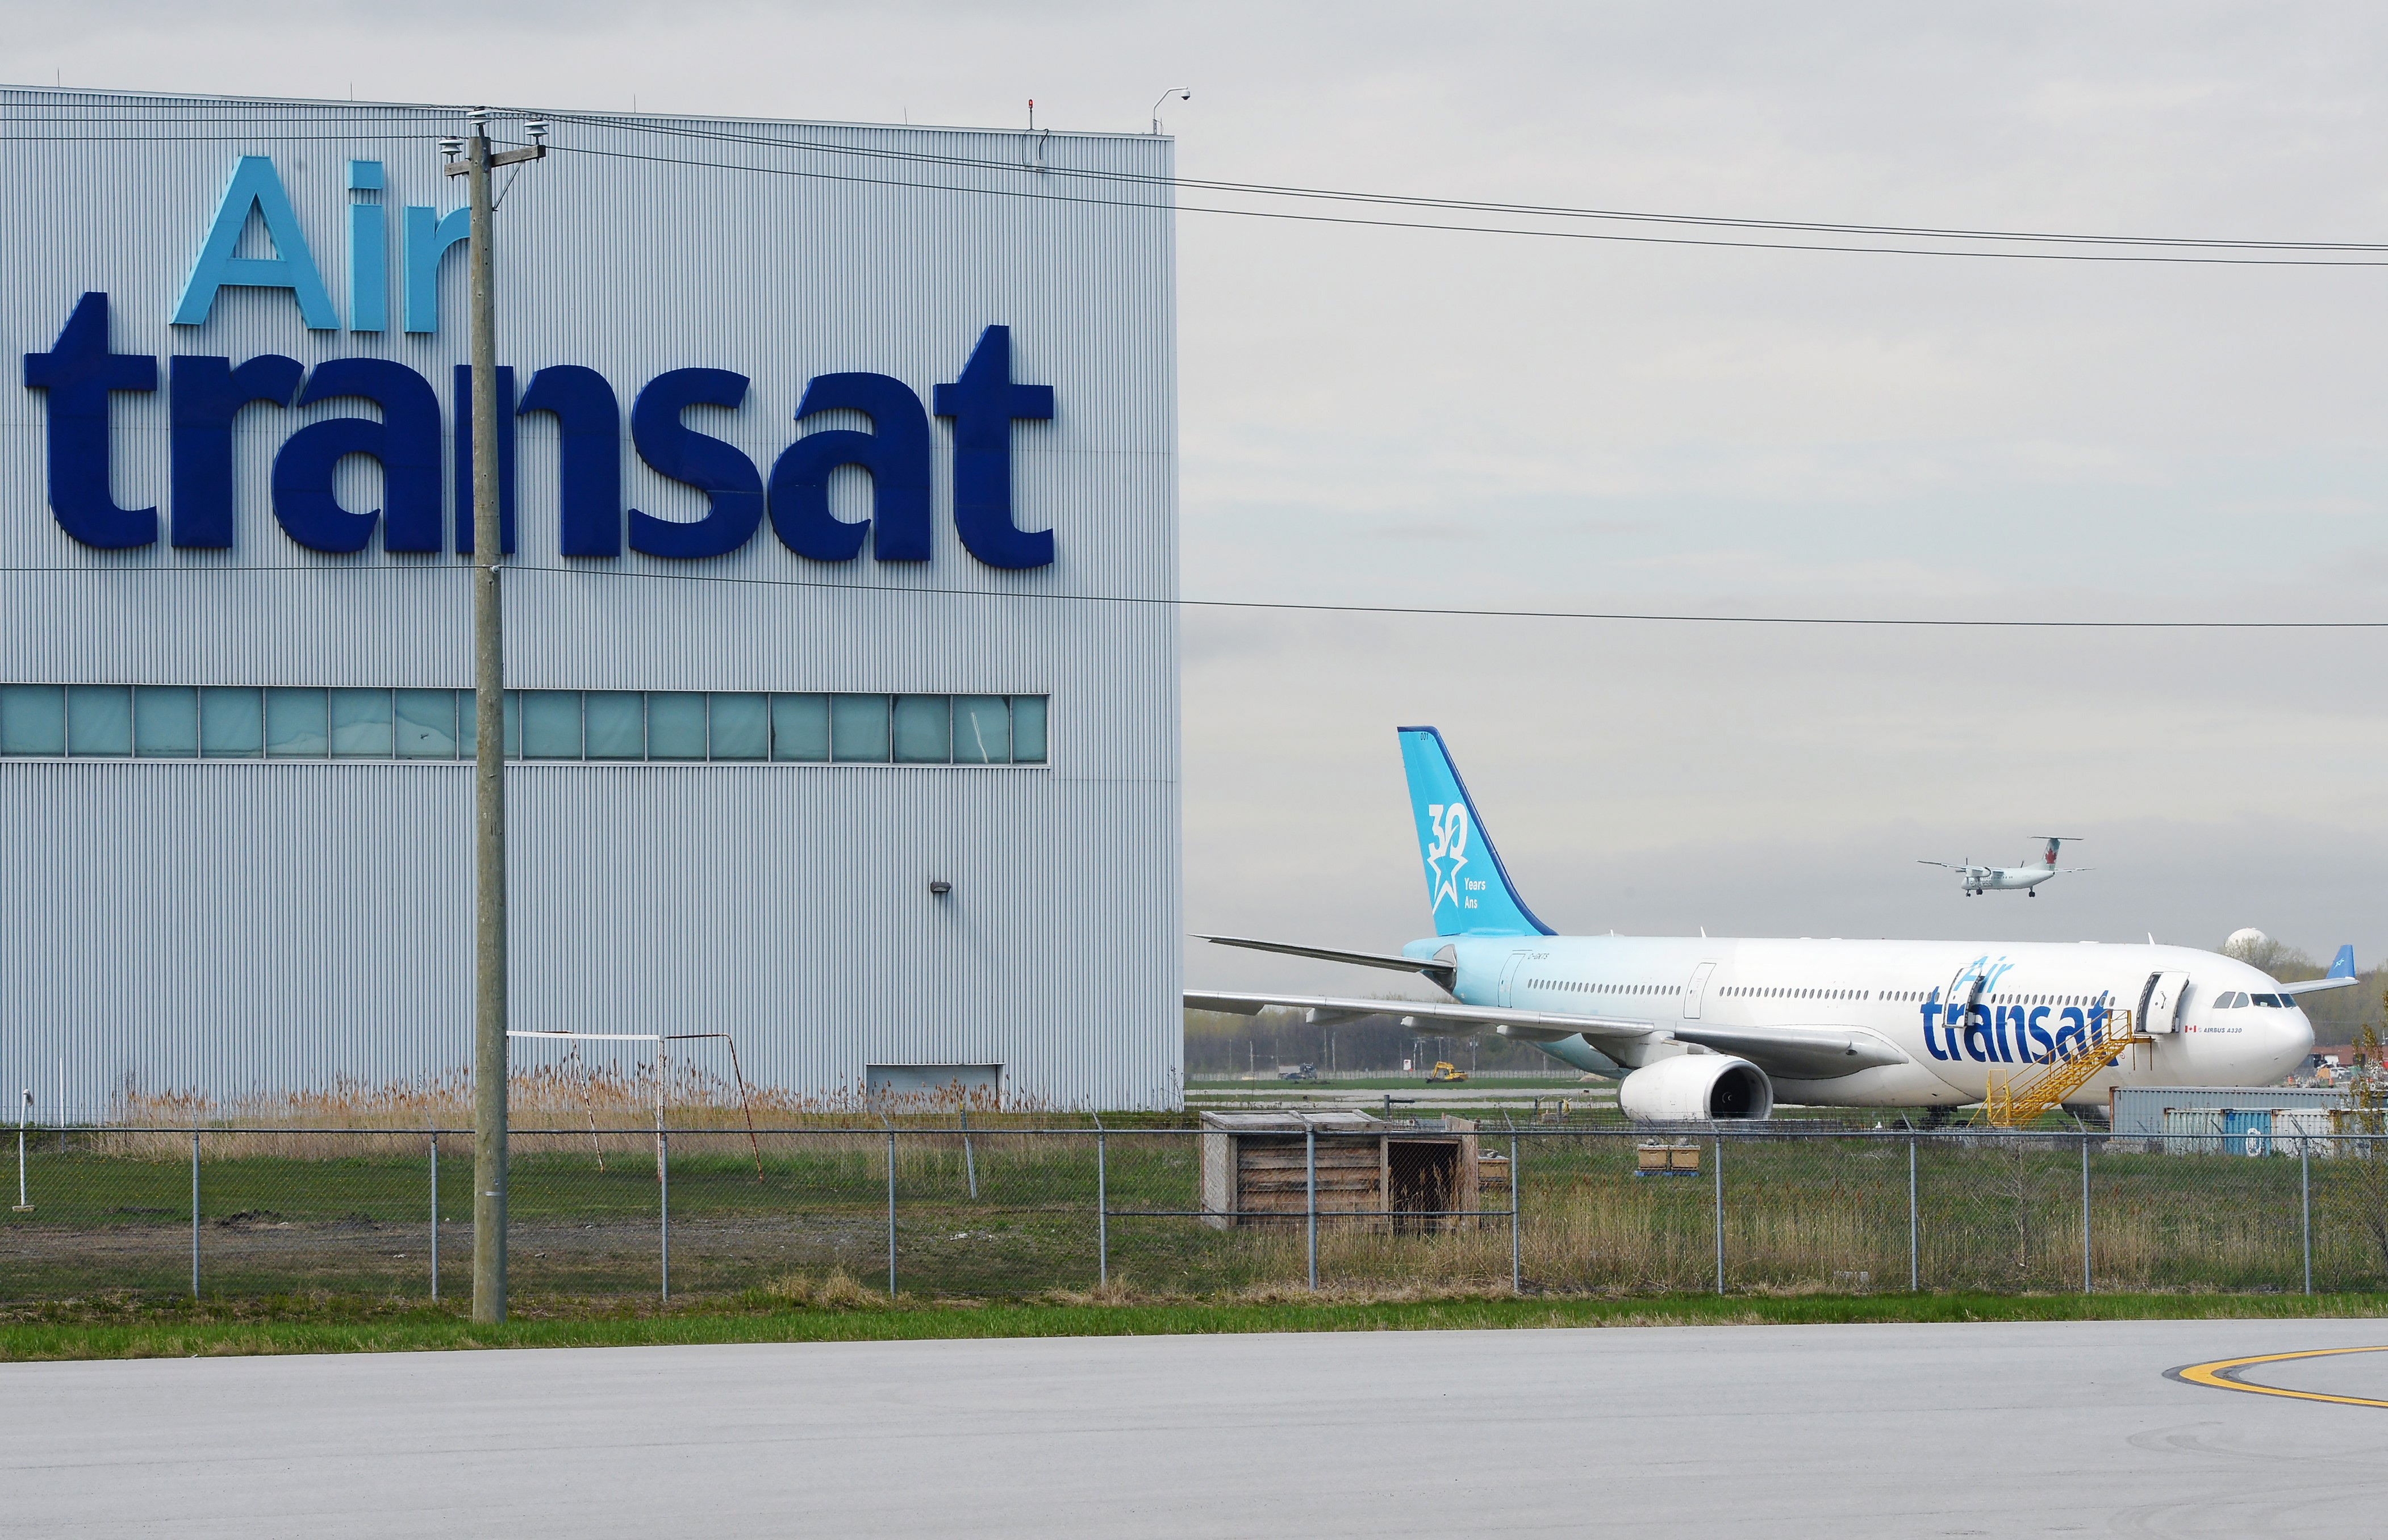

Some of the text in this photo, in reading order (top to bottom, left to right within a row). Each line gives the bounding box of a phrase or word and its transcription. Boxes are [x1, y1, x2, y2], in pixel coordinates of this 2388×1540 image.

[169, 156, 471, 333] Air
[24, 291, 1054, 569] transat
[1428, 802, 1468, 857] 30
[1464, 877, 1485, 890] Years
[1464, 895, 1477, 909] Ans
[1953, 956, 2015, 993] Air
[1920, 986, 2119, 1067] transat
